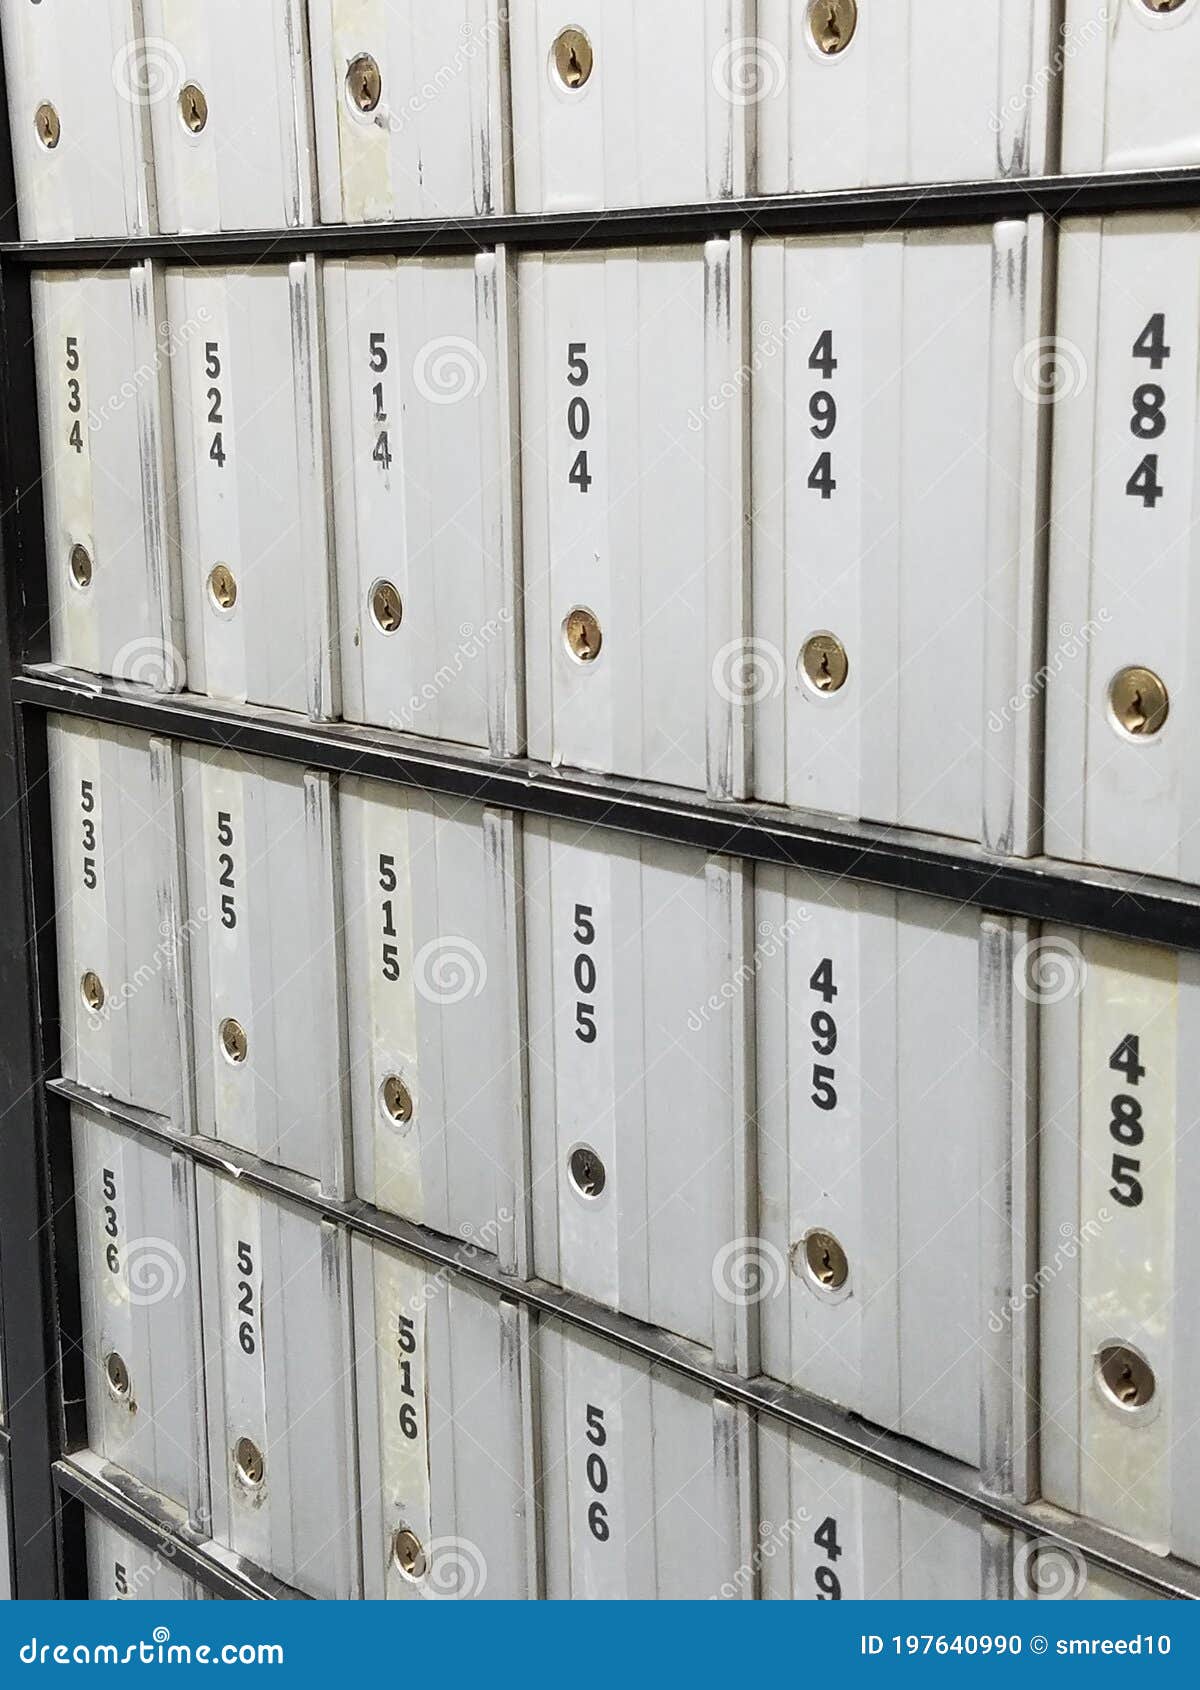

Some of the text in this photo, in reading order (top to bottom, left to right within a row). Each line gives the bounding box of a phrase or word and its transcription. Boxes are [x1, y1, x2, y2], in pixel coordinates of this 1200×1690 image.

[66, 336, 84, 454] 534
[205, 342, 226, 468] 524
[369, 332, 392, 470] 514
[567, 342, 592, 493] 504
[807, 330, 838, 499] 494
[1126, 313, 1171, 508] 484
[81, 779, 97, 890] 535
[217, 811, 237, 929] 525
[379, 853, 400, 982] 515
[573, 903, 597, 1044] 505
[809, 957, 838, 1111] 495
[1109, 1033, 1146, 1208] 485
[103, 1168, 119, 1273] 536
[237, 1240, 255, 1355] 526
[397, 1314, 418, 1440] 516
[585, 1403, 610, 1542] 506
